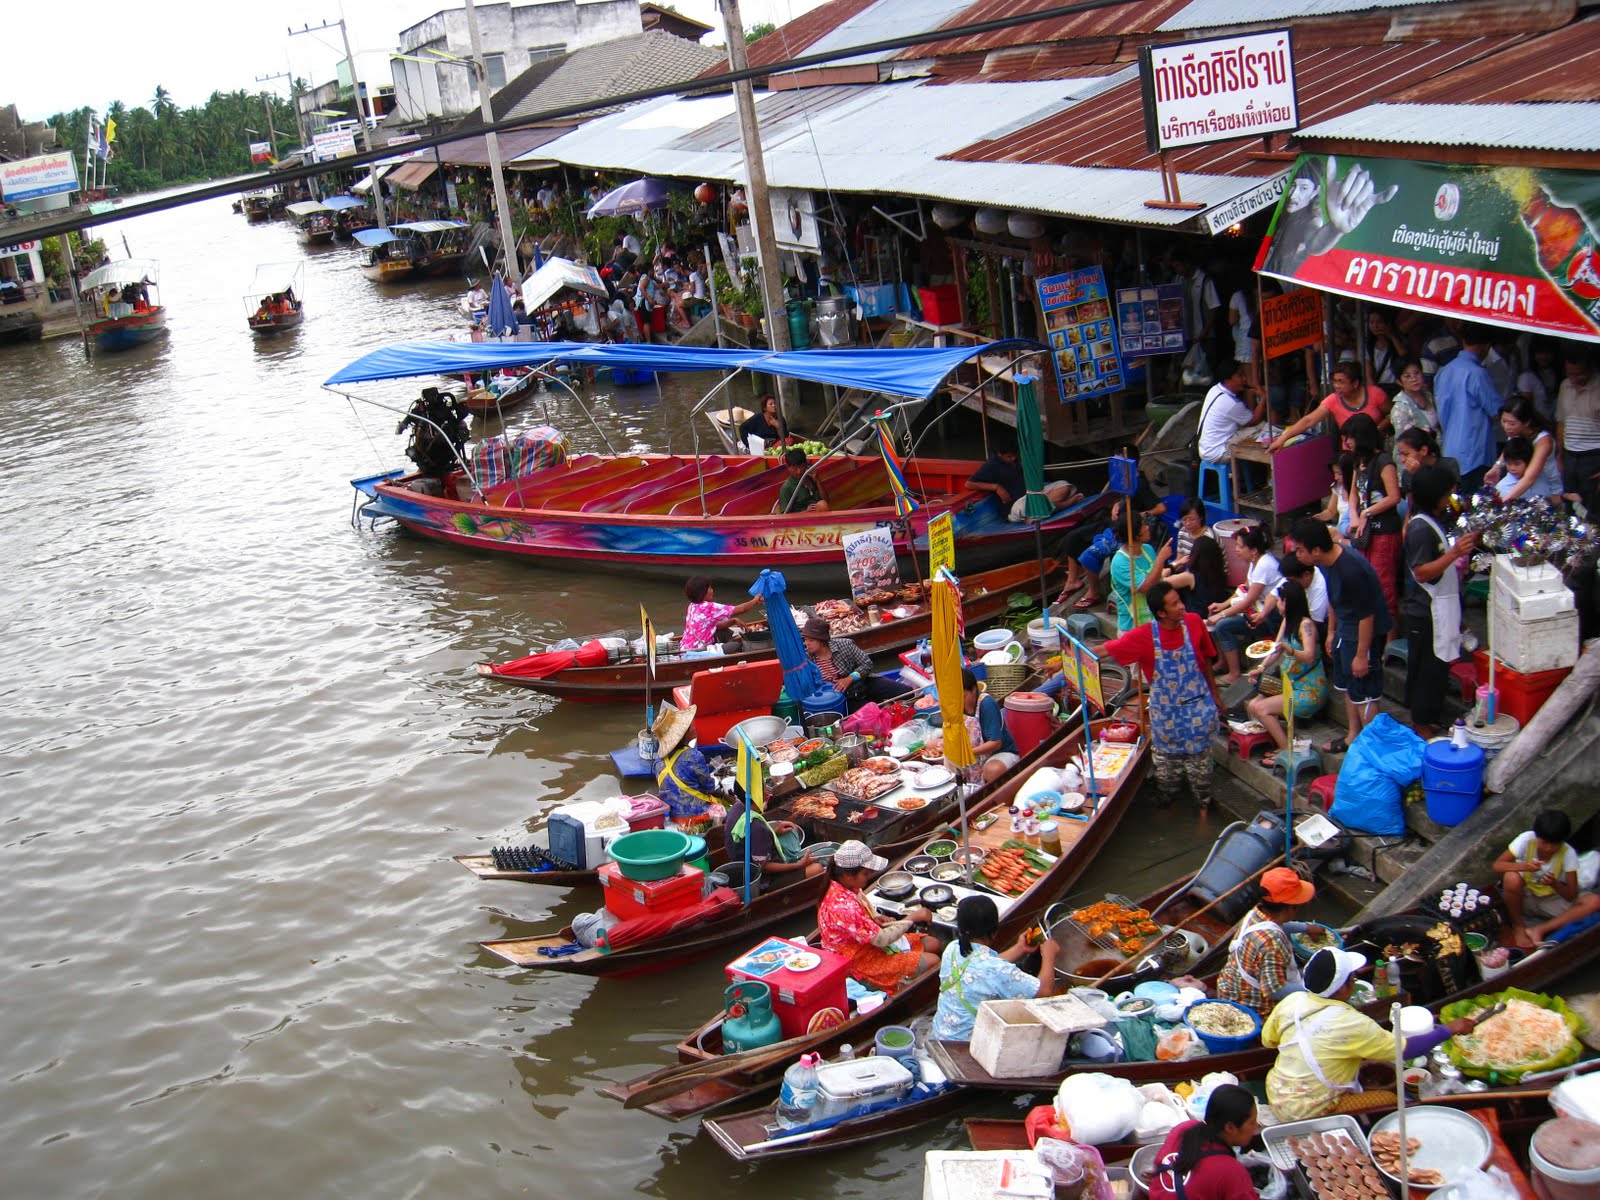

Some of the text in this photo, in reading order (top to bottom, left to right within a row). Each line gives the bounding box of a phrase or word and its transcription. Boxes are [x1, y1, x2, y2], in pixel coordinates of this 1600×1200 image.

[1155, 40, 1287, 102] ท่าเรือศิริโรจน์
[1161, 99, 1291, 140] บริการเรือชมหิ่งห้อย
[1392, 224, 1500, 261] เชิดชูนักสู้ผู้ยิ่งใหญ่
[1345, 256, 1537, 316] คาราบาวแดง
